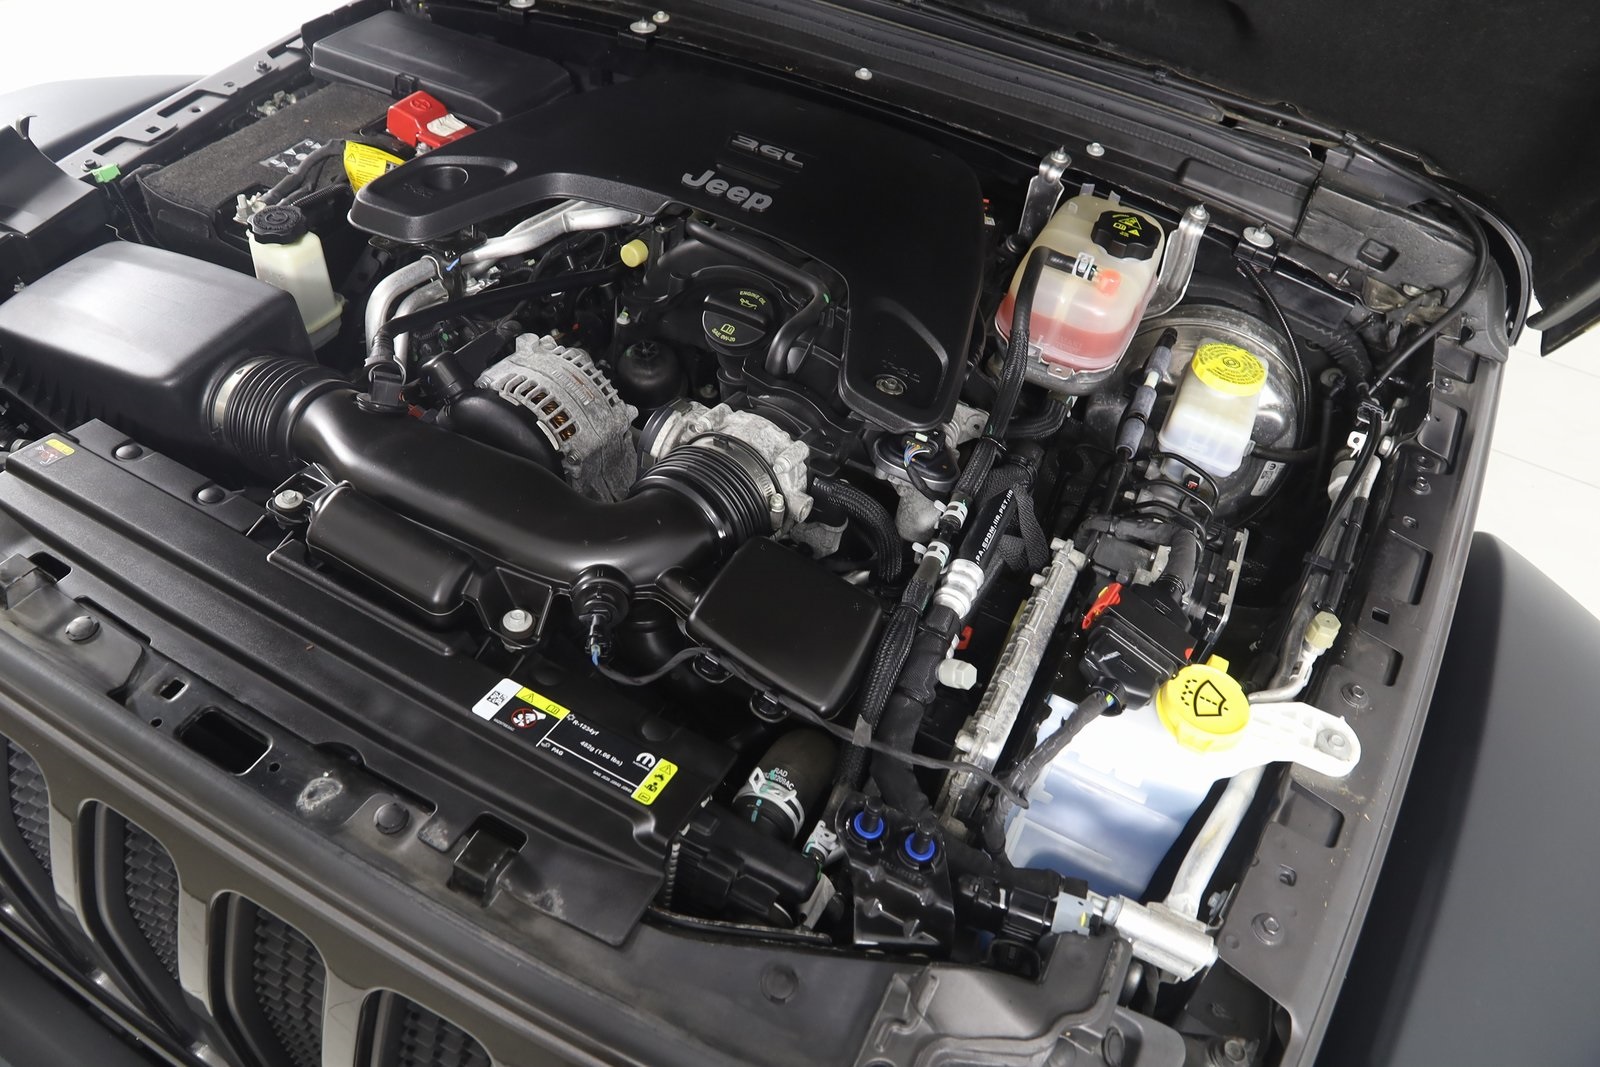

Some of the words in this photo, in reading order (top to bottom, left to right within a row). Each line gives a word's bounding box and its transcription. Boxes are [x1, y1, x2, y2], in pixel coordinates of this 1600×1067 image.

[681, 169, 773, 212] Jeep
[739, 290, 760, 300] ENGINE
[711, 327, 721, 338] SAE
[572, 719, 600, 737] R-1234yf
[551, 746, 564, 756] PAG
[610, 756, 624, 767] lbs)
[774, 767, 788, 777] RAD
